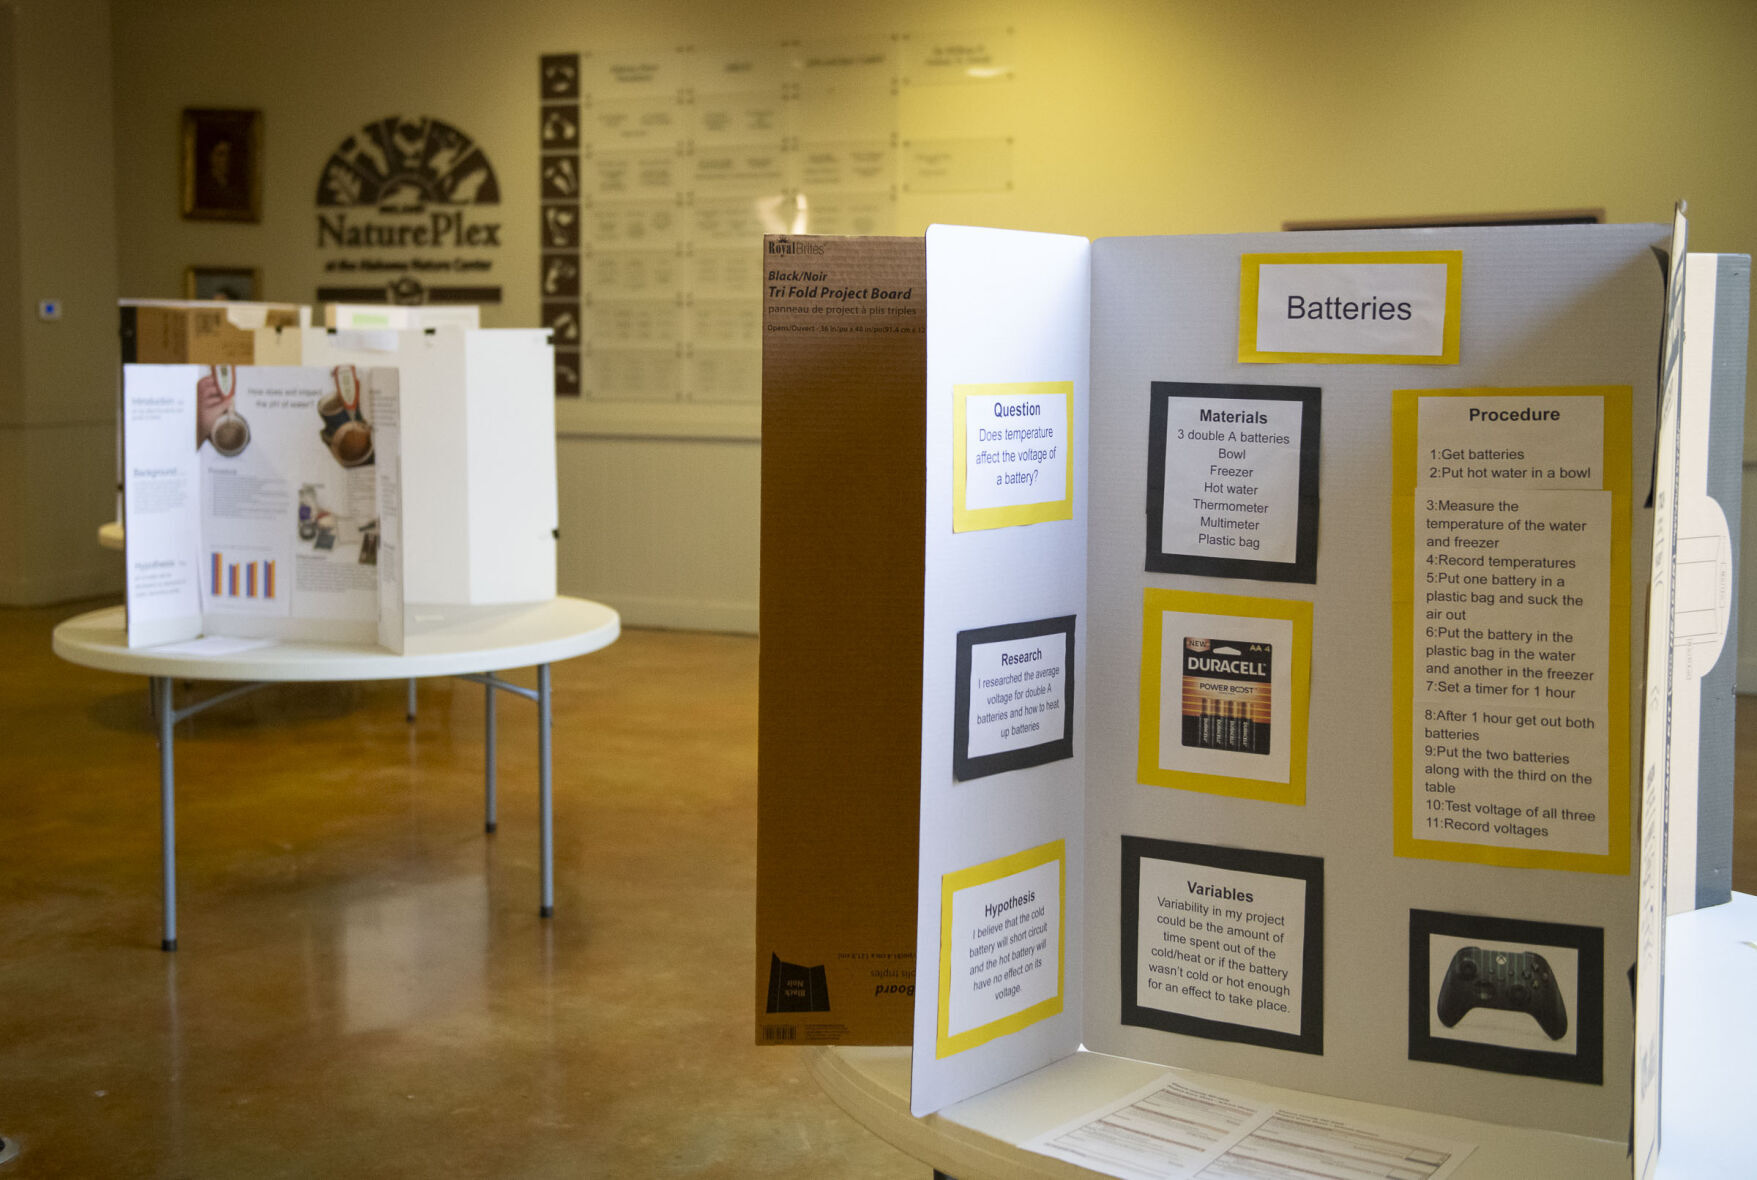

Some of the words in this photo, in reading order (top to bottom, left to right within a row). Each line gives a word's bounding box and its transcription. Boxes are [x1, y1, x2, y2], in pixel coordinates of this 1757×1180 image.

[316, 211, 502, 248] NaturePlex
[768, 271, 828, 281] Black/Noir
[769, 287, 785, 298] Tri
[789, 287, 818, 298] Fold
[820, 287, 868, 302] Project
[871, 288, 912, 300] Board
[768, 306, 809, 314] panneau
[812, 305, 823, 314] de
[826, 305, 859, 316] project
[861, 306, 867, 314] à
[870, 305, 885, 315] plis
[888, 306, 917, 317] triples
[1287, 295, 1412, 320] Batteries
[994, 402, 1041, 418] Question
[1200, 409, 1267, 424] Materials
[1469, 408, 1560, 421] Procedure
[979, 428, 1002, 442] Does
[1005, 426, 1053, 442] temperature
[1188, 429, 1225, 441] double
[1241, 432, 1289, 444] batteries
[976, 450, 999, 464] affect
[1018, 448, 1046, 463] voltage
[1219, 449, 1246, 460] Bowl
[1430, 449, 1464, 460] 1:Get
[1469, 449, 1525, 460] batteries
[1005, 469, 1038, 486] battery?
[1210, 465, 1253, 477] Freezer
[1430, 467, 1463, 478] 2:Put
[1491, 469, 1527, 478] water
[1560, 467, 1590, 478] bowl
[1227, 484, 1258, 495] water
[1193, 499, 1269, 513] Thermometer
[1426, 500, 1494, 511] 3:Measure
[1201, 517, 1260, 530] Multimeter
[1426, 519, 1504, 532] temperature
[1549, 521, 1586, 532] water
[1199, 534, 1235, 546] Plastic
[1239, 537, 1260, 550] bag
[1426, 537, 1449, 547] and
[1454, 537, 1499, 548] freezer
[1426, 555, 1484, 566] 4:Record
[1488, 558, 1576, 571] temperatures
[1426, 573, 1459, 584] 5:Put
[1492, 575, 1536, 588] battery
[1426, 591, 1467, 605] plastic
[1471, 592, 1495, 605] bag
[1499, 594, 1523, 604] and
[1528, 595, 1558, 605] suck
[1562, 595, 1583, 606] the
[1426, 627, 1459, 639] 6:Put
[1488, 630, 1532, 643] battery
[1552, 632, 1573, 643] the
[1189, 640, 1207, 648] NEW
[1002, 648, 1042, 666] Research
[1426, 646, 1467, 658] plastic
[1471, 647, 1494, 660] bag
[1539, 651, 1575, 661] water
[1188, 657, 1266, 676] DURACELL
[1426, 664, 1449, 674] and
[1454, 665, 1503, 677] another
[1547, 668, 1594, 681] freezer
[983, 672, 1022, 688] researched
[1036, 666, 1059, 678] average
[987, 692, 1013, 704] voltage
[1025, 686, 1046, 698] double
[1200, 683, 1228, 692] POWER
[1230, 686, 1254, 694] BOOST
[1426, 681, 1459, 692] 7:Set
[1475, 683, 1507, 695] timer
[1546, 687, 1575, 698] hour
[977, 711, 1008, 724] batteries
[1425, 710, 1467, 722] 8:After
[1483, 713, 1512, 724] hour
[1516, 716, 1536, 728] get
[1566, 718, 1595, 729] both
[1011, 721, 1039, 735] batteries
[1425, 728, 1480, 741] batteries
[1425, 746, 1458, 758] 9:Put
[1513, 752, 1569, 765] batteries
[1425, 765, 1459, 777] along
[1464, 767, 1489, 778] with
[1518, 770, 1546, 781] third
[1572, 773, 1592, 784] the
[1425, 783, 1456, 793] table
[1426, 800, 1471, 812] 10:Test
[1475, 805, 1521, 818] voltage
[1562, 810, 1595, 821] three
[1426, 817, 1490, 832] 11:Record
[1494, 823, 1549, 838] voltages
[1187, 881, 1254, 902] Variables
[985, 891, 1035, 919] Hypothesis
[1157, 896, 1209, 916] Variability
[1246, 912, 1285, 926] project
[978, 923, 1003, 938] believe
[1157, 915, 1186, 927] could
[1227, 927, 1269, 941] amount
[969, 942, 995, 958] battery
[1010, 932, 1027, 945] short
[1028, 923, 1047, 938] circuit
[1163, 931, 1186, 944] time
[1189, 936, 1220, 949] spent
[1012, 946, 1035, 960] battery
[1151, 946, 1201, 963] cold/heat
[1249, 962, 1288, 980] battery
[973, 978, 991, 991] have
[1004, 967, 1023, 980] effect
[1186, 969, 1208, 982] cold
[1248, 981, 1290, 997] enough
[875, 985, 915, 996] Board
[995, 986, 1022, 1000] voltage.
[1182, 985, 1211, 1000] effect
[1229, 994, 1253, 1006] take
[1256, 999, 1290, 1014] place.
